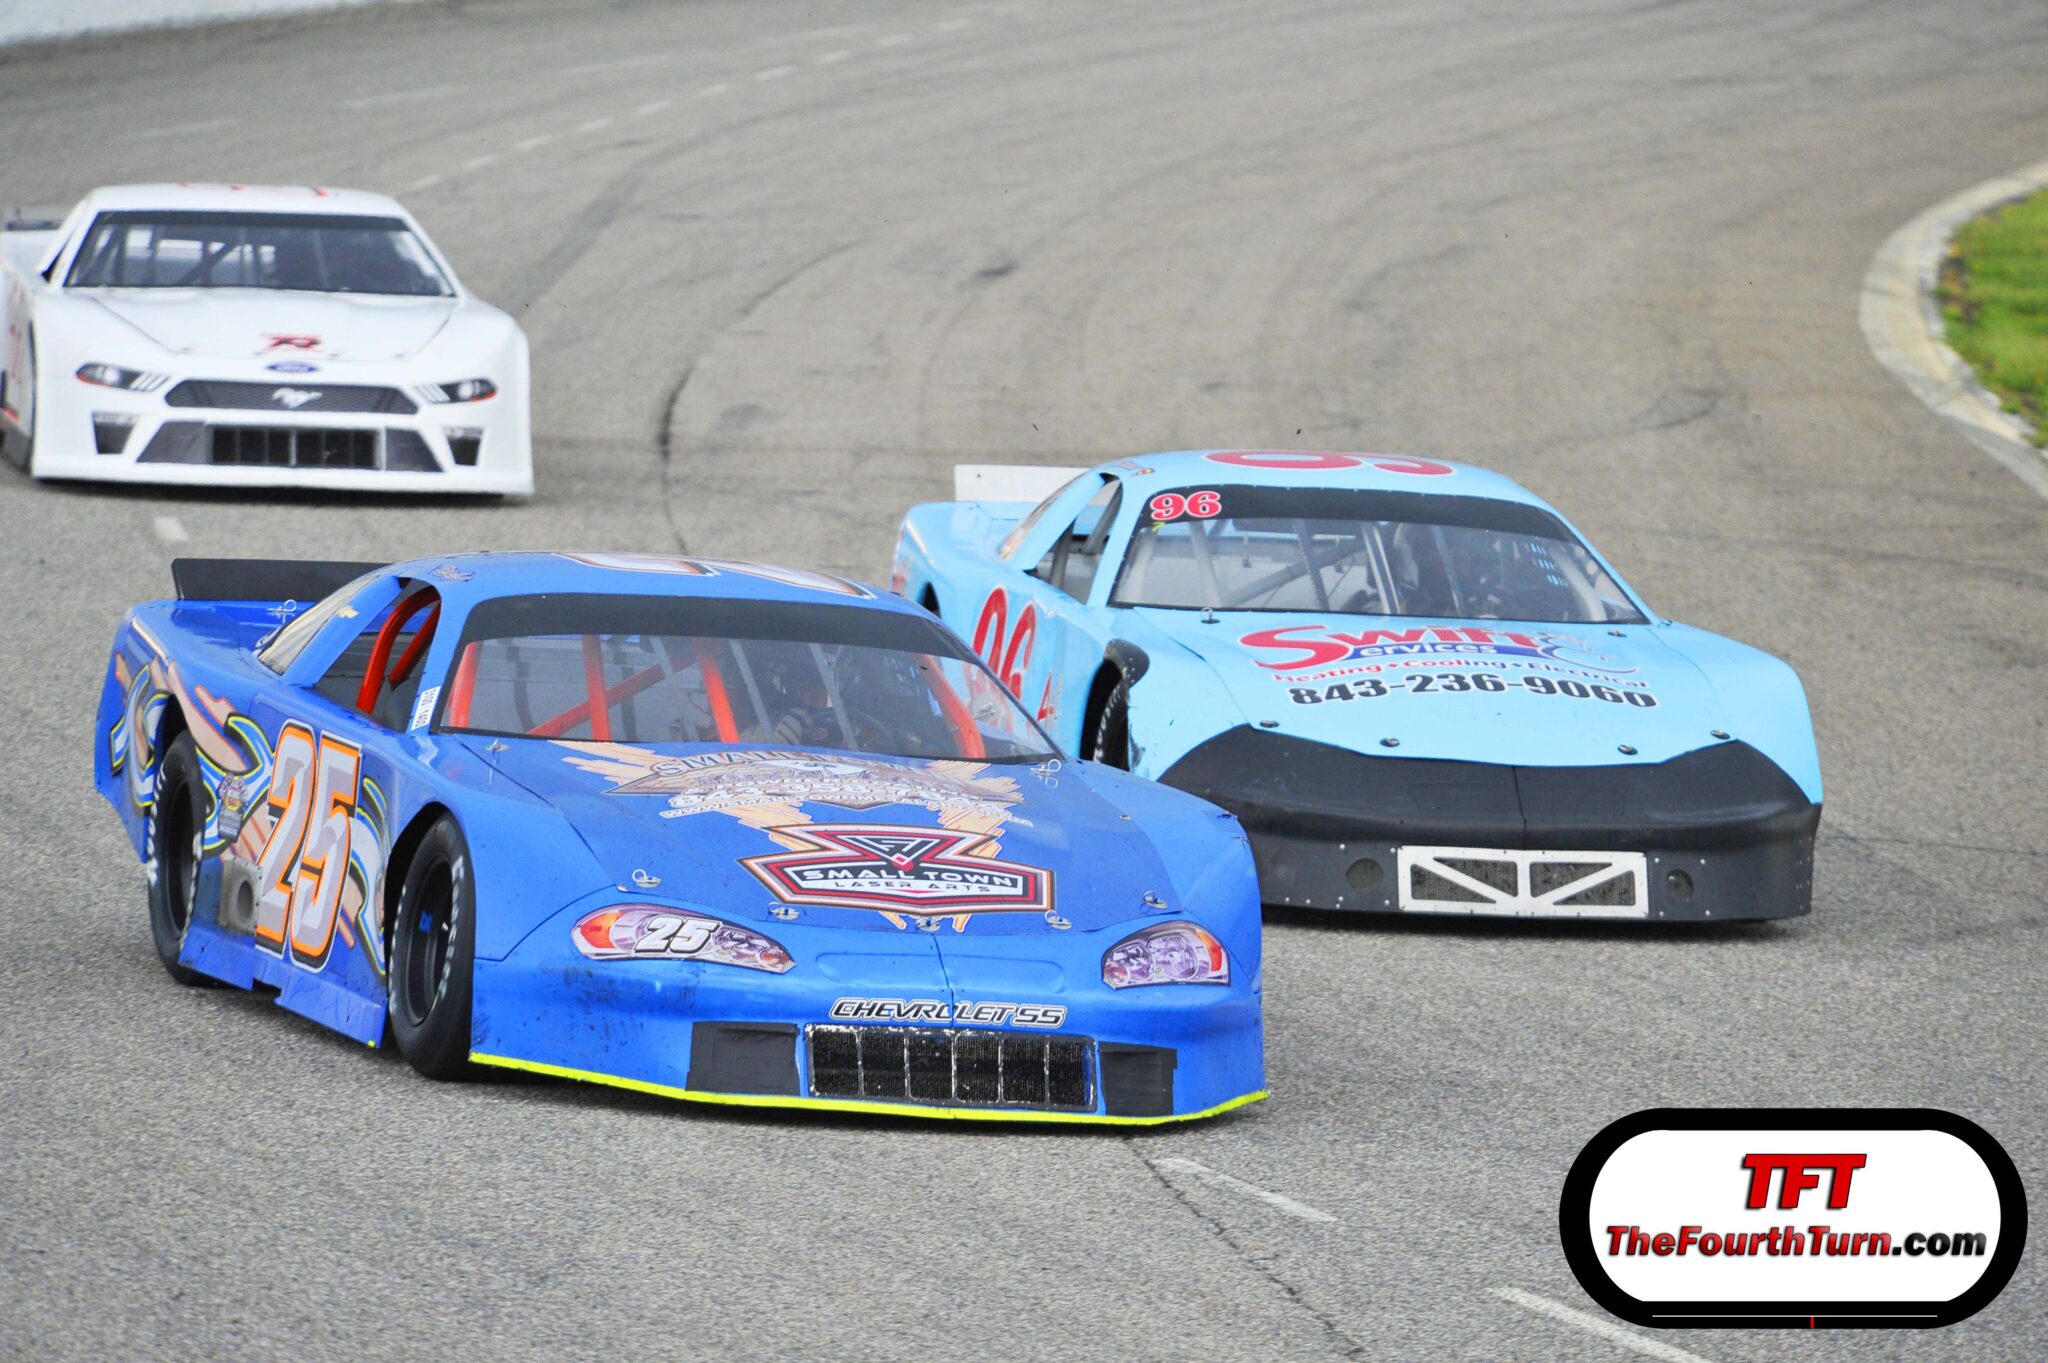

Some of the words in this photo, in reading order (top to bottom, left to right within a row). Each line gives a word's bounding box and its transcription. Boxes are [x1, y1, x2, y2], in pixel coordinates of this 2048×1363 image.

[1150, 490, 1222, 521] 96
[1273, 663, 1383, 683] Heating
[1403, 656, 1508, 670] Cooling
[1288, 672, 1658, 709] 843-236-9060
[254, 718, 362, 974] 25
[802, 869, 915, 882] SMALL
[922, 870, 1012, 887] TOWN
[834, 880, 912, 889] LASER
[928, 882, 991, 893] ARTS
[634, 914, 722, 954] 25
[831, 999, 1016, 1025] CHEVROLET
[1011, 1004, 1066, 1027] SS
